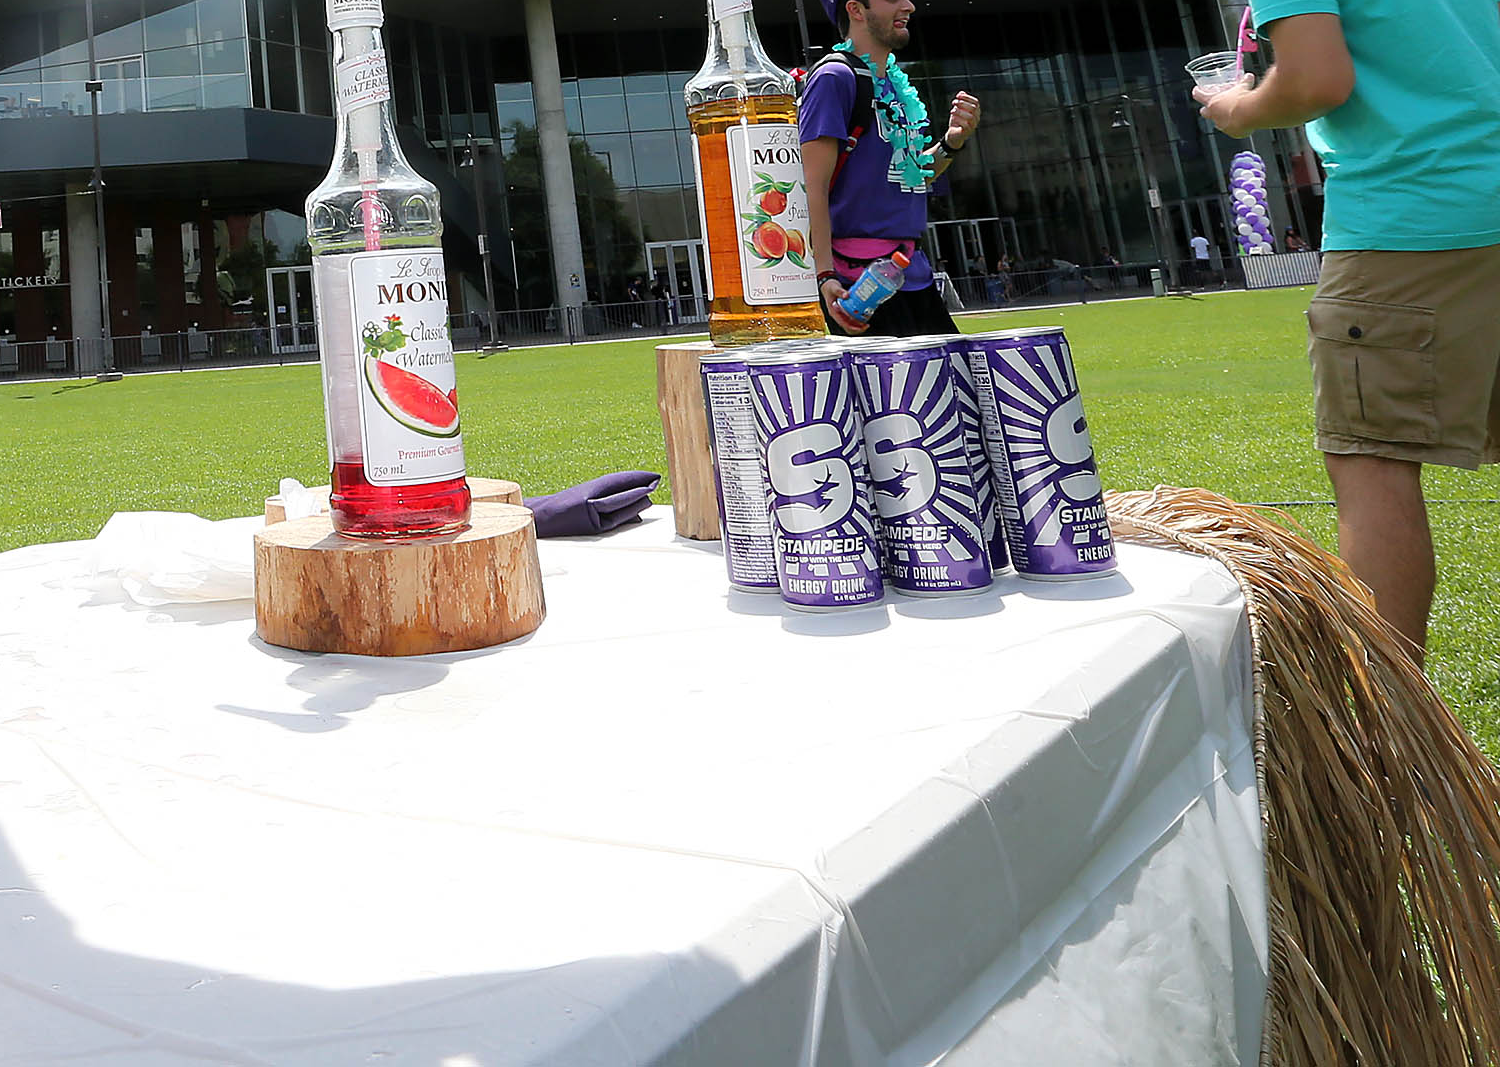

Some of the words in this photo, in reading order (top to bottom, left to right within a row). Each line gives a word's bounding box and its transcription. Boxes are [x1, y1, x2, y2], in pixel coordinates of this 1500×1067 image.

[390, 258, 413, 278] Le
[1, 275, 57, 288] TICKETS
[397, 447, 436, 460] Premium
[885, 525, 948, 542] AMPEDE
[779, 537, 865, 555] STAMPEDE
[1077, 544, 1112, 563] ENERGY
[912, 565, 949, 581] DRINK
[788, 577, 828, 595] ENERGY
[831, 577, 867, 594] DRINK
